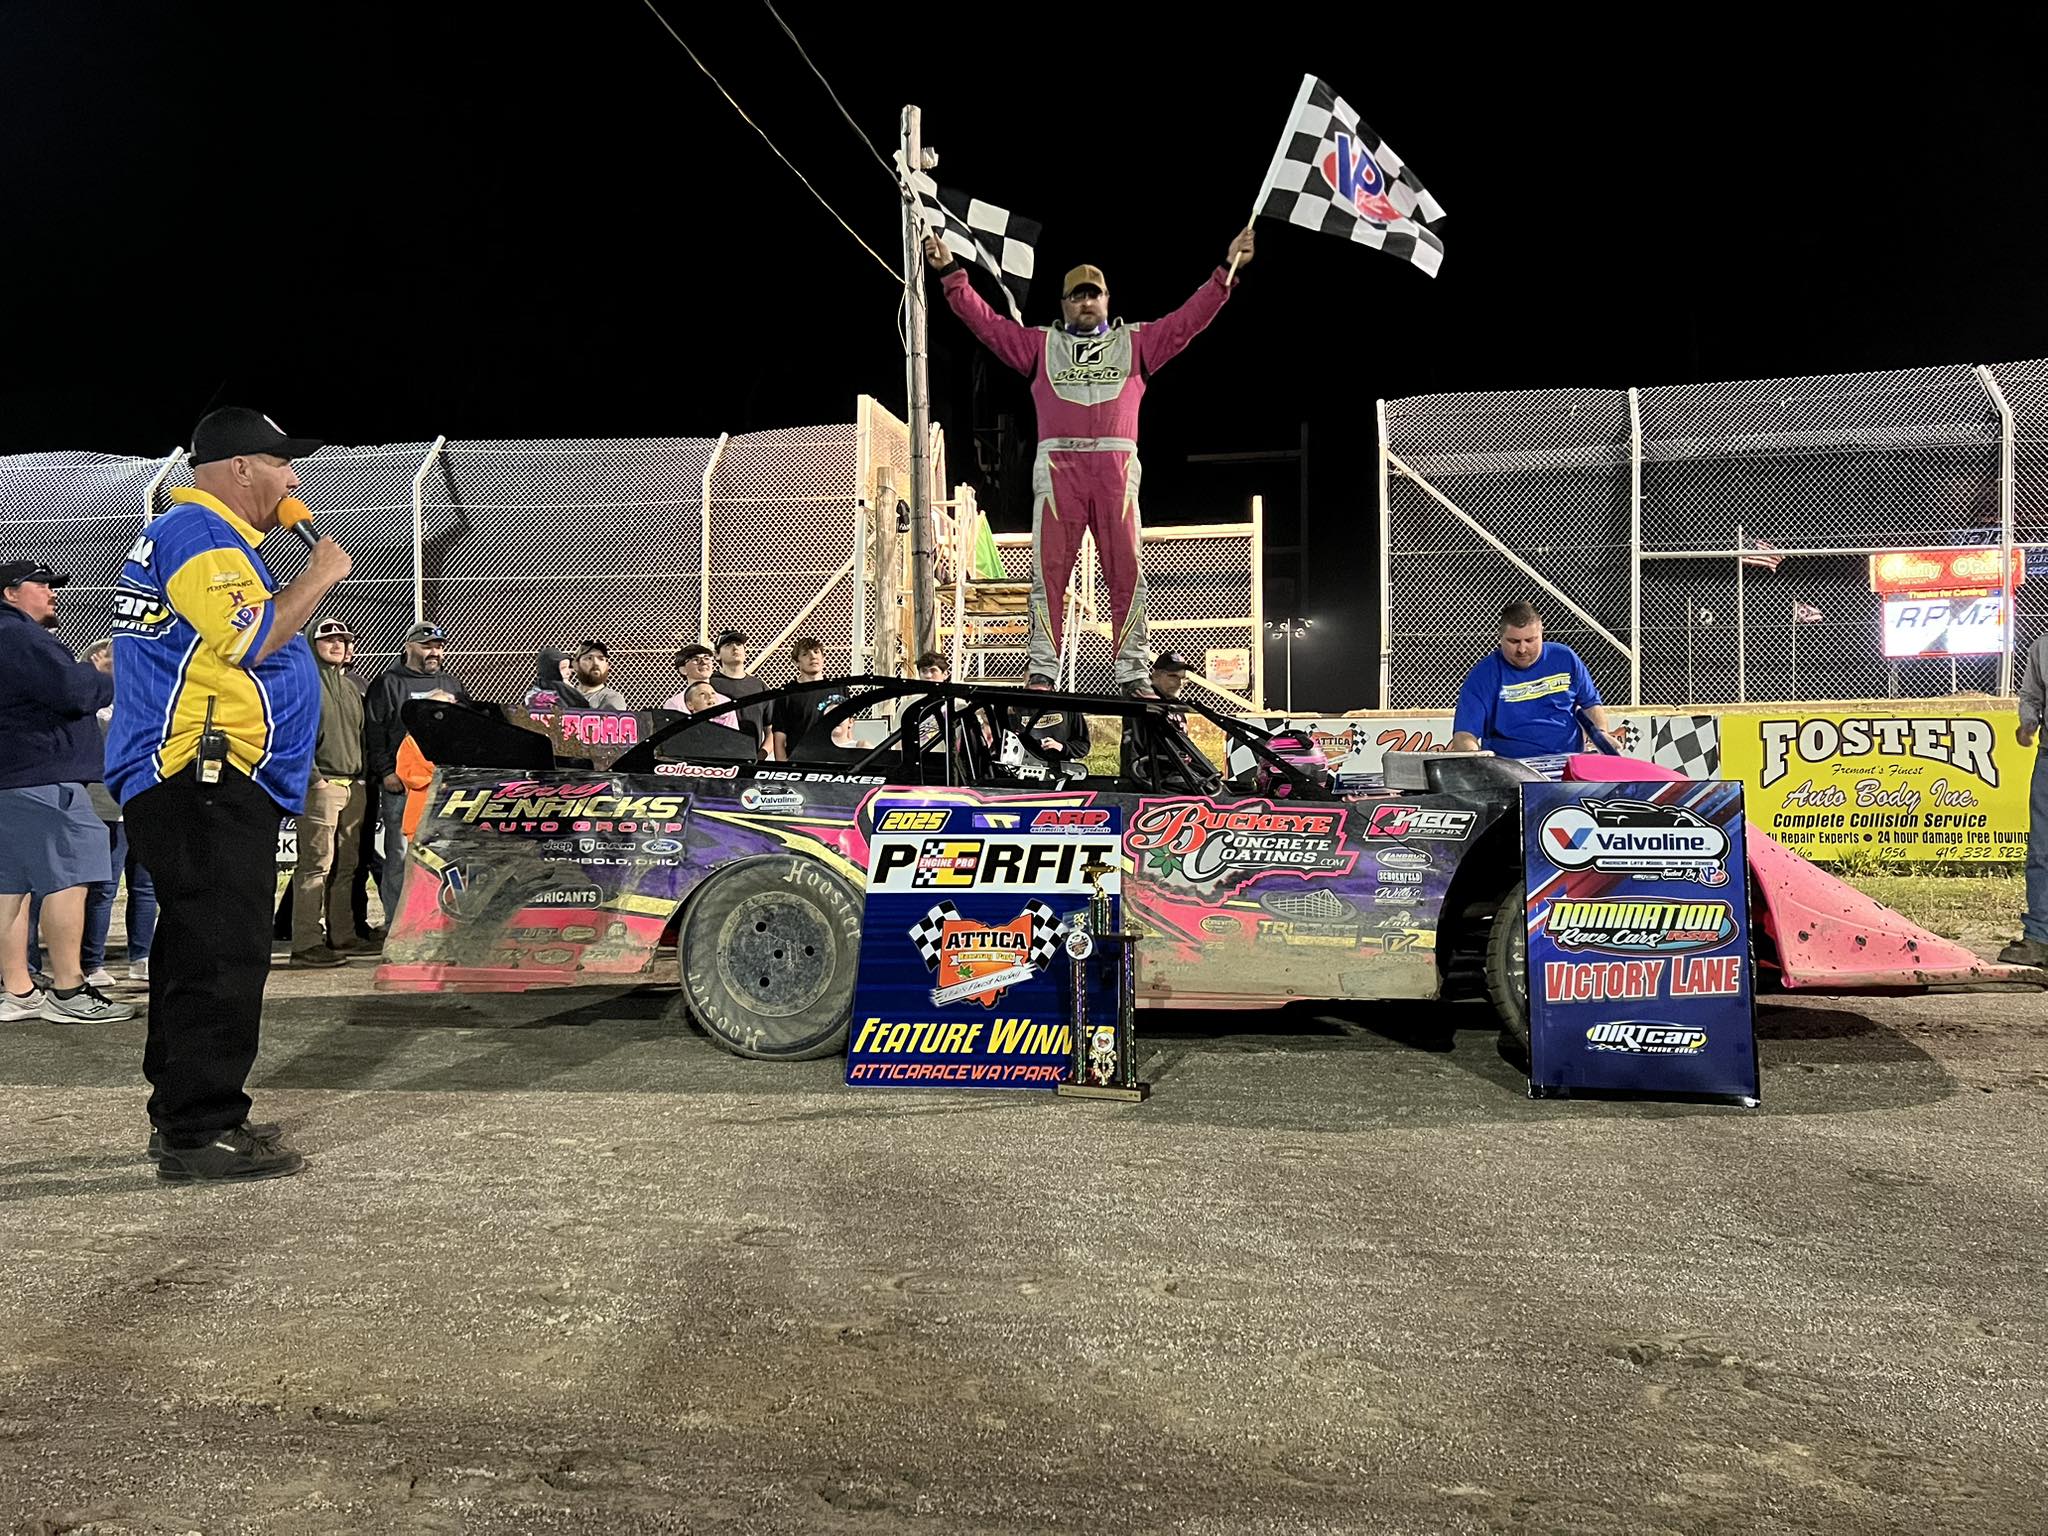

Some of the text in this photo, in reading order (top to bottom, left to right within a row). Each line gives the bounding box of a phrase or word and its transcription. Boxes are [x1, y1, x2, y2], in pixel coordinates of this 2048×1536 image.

[1760, 718, 2000, 789] FOSTER
[754, 770, 803, 782] DISC
[804, 773, 887, 785] BRAKES
[1832, 763, 1924, 776] Fremont's Finest
[1782, 778, 1979, 815] Auto Body Inc.
[479, 820, 684, 834] AUTO GROUP
[881, 812, 945, 831] 2025
[1033, 810, 1109, 826] ARP
[1773, 812, 1988, 829] Complete Collision Service
[1130, 803, 1334, 854] BUCKEYE
[543, 840, 574, 854] Jeep
[1596, 833, 1705, 851] Valvoline
[1781, 831, 1816, 845] Repair
[1818, 831, 1860, 845] Experts
[1877, 831, 1891, 844] 24
[1893, 831, 1919, 844] hour
[1922, 831, 1964, 844] damage
[1966, 831, 1990, 844] free
[1993, 831, 2030, 845] towing
[1879, 847, 1907, 859] 1956
[918, 857, 976, 869] ENGINE PRO
[1548, 902, 1726, 931] DOMINATION
[944, 932, 1028, 950] ATTICA
[1557, 928, 1610, 946] Race
[1611, 928, 1669, 948] Cars
[1545, 955, 1742, 1001] VICTORY LANE
[852, 1017, 984, 1054] FEATURE
[1590, 1023, 1704, 1049] DIRTcar
